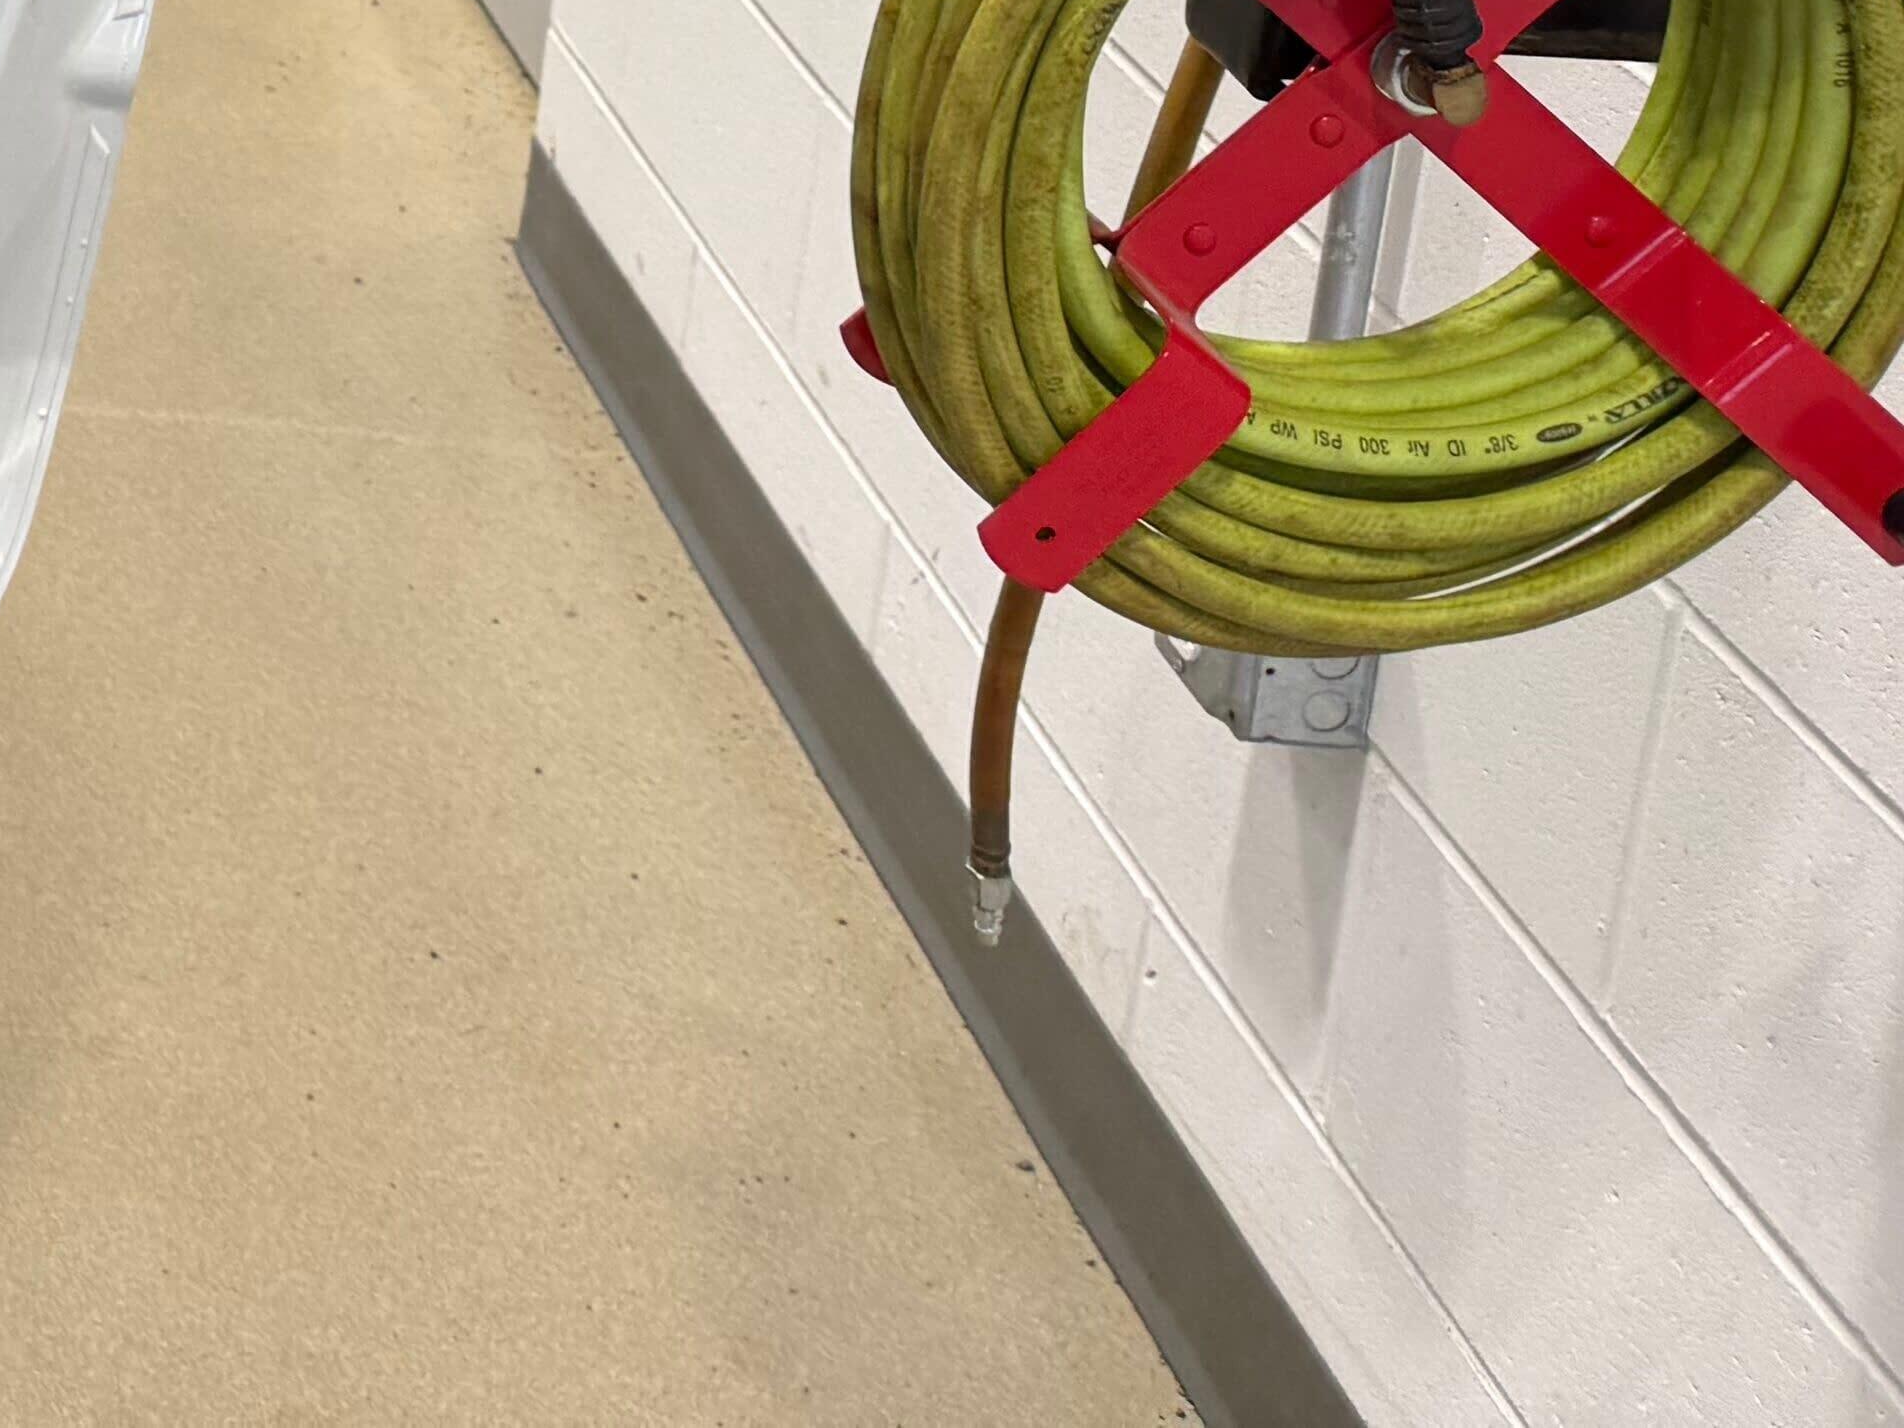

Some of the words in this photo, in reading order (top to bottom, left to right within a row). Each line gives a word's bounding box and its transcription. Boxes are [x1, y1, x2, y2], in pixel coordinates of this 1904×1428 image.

[1270, 419, 1298, 440] WP
[1313, 429, 1343, 450] PSI
[1359, 436, 1391, 456] 300
[1408, 440, 1430, 457] Air
[1448, 439, 1467, 457] ID
